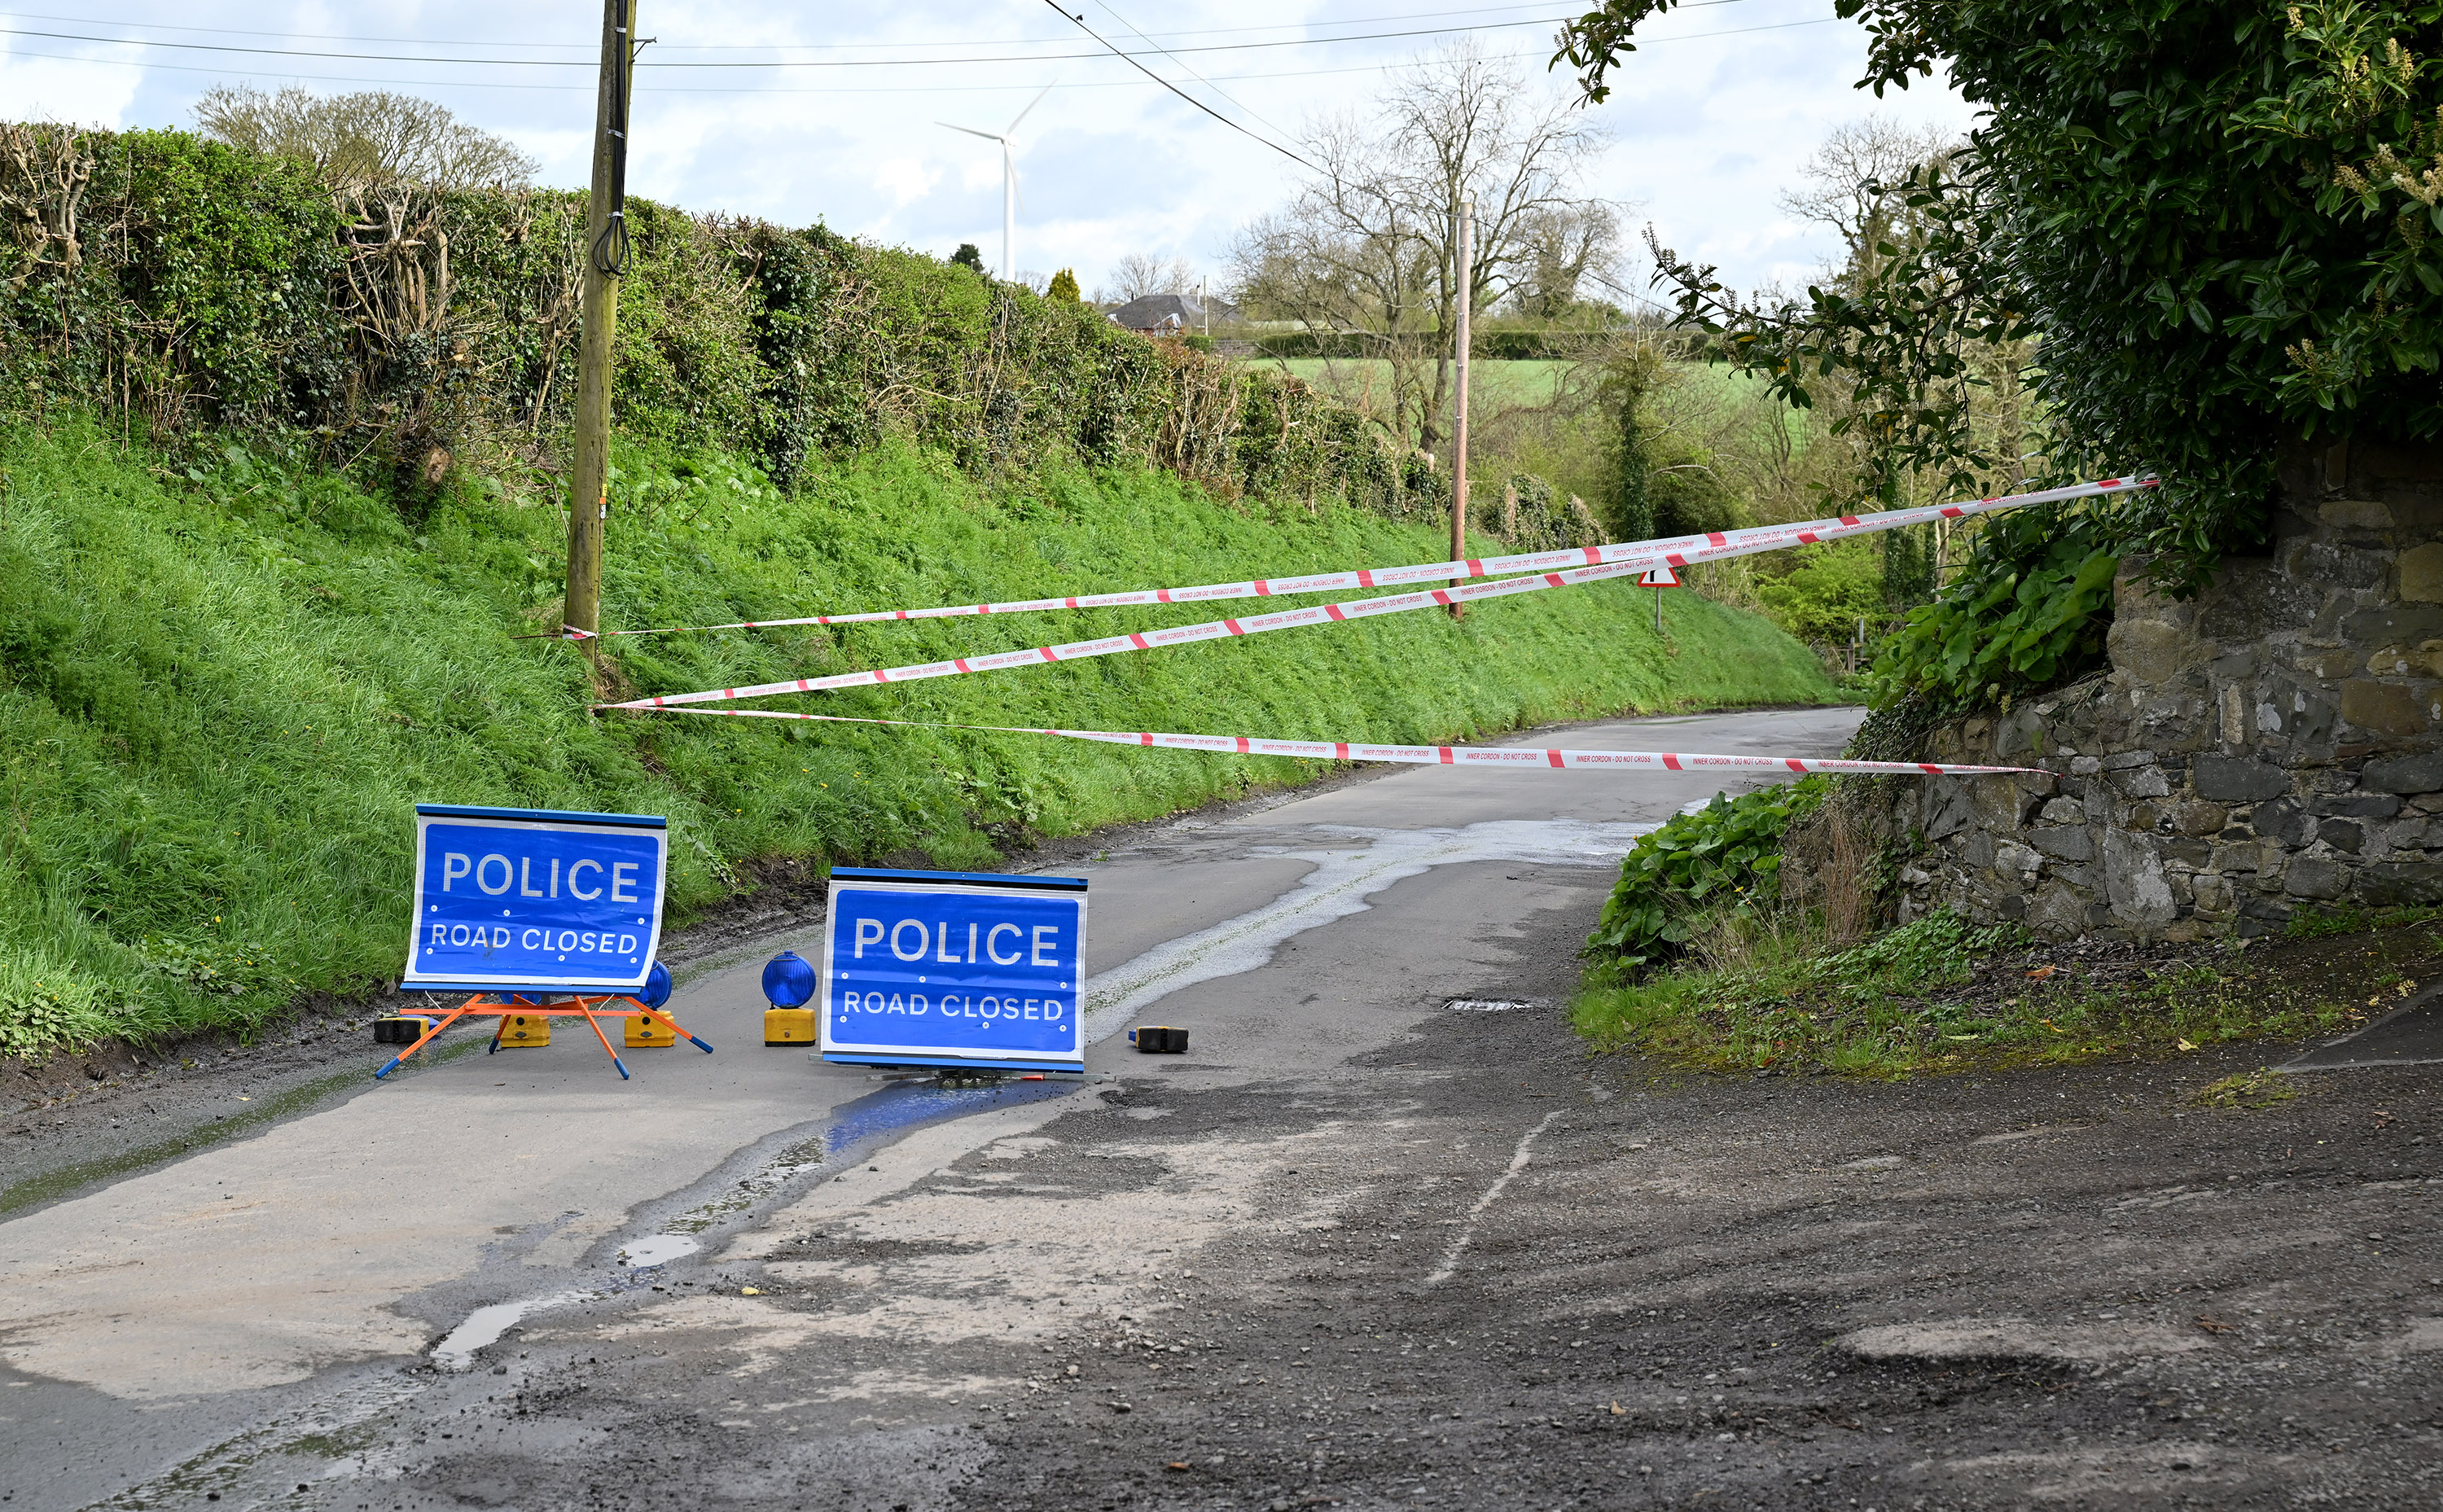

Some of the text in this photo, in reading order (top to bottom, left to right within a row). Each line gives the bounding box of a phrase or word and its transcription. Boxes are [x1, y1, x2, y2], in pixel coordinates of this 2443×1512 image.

[1655, 542, 1677, 551] CORDON
[1716, 545, 1738, 554] CORDON
[1534, 556, 1555, 564] CORDON
[1590, 566, 1612, 575] CORDON
[1636, 558, 1654, 566] CROSS
[1476, 584, 1496, 593] CORDON
[1518, 577, 1534, 586] CROSS
[1368, 602, 1386, 610] CORDON
[1407, 595, 1422, 603] CROSS
[1264, 617, 1284, 625] CORDON
[1303, 611, 1317, 619] CROSS
[443, 852, 639, 903] POLICE
[431, 924, 638, 954] ROAD CLOSED
[854, 918, 1059, 967] POLICE
[844, 991, 1063, 1021] ROAD CLOSED
